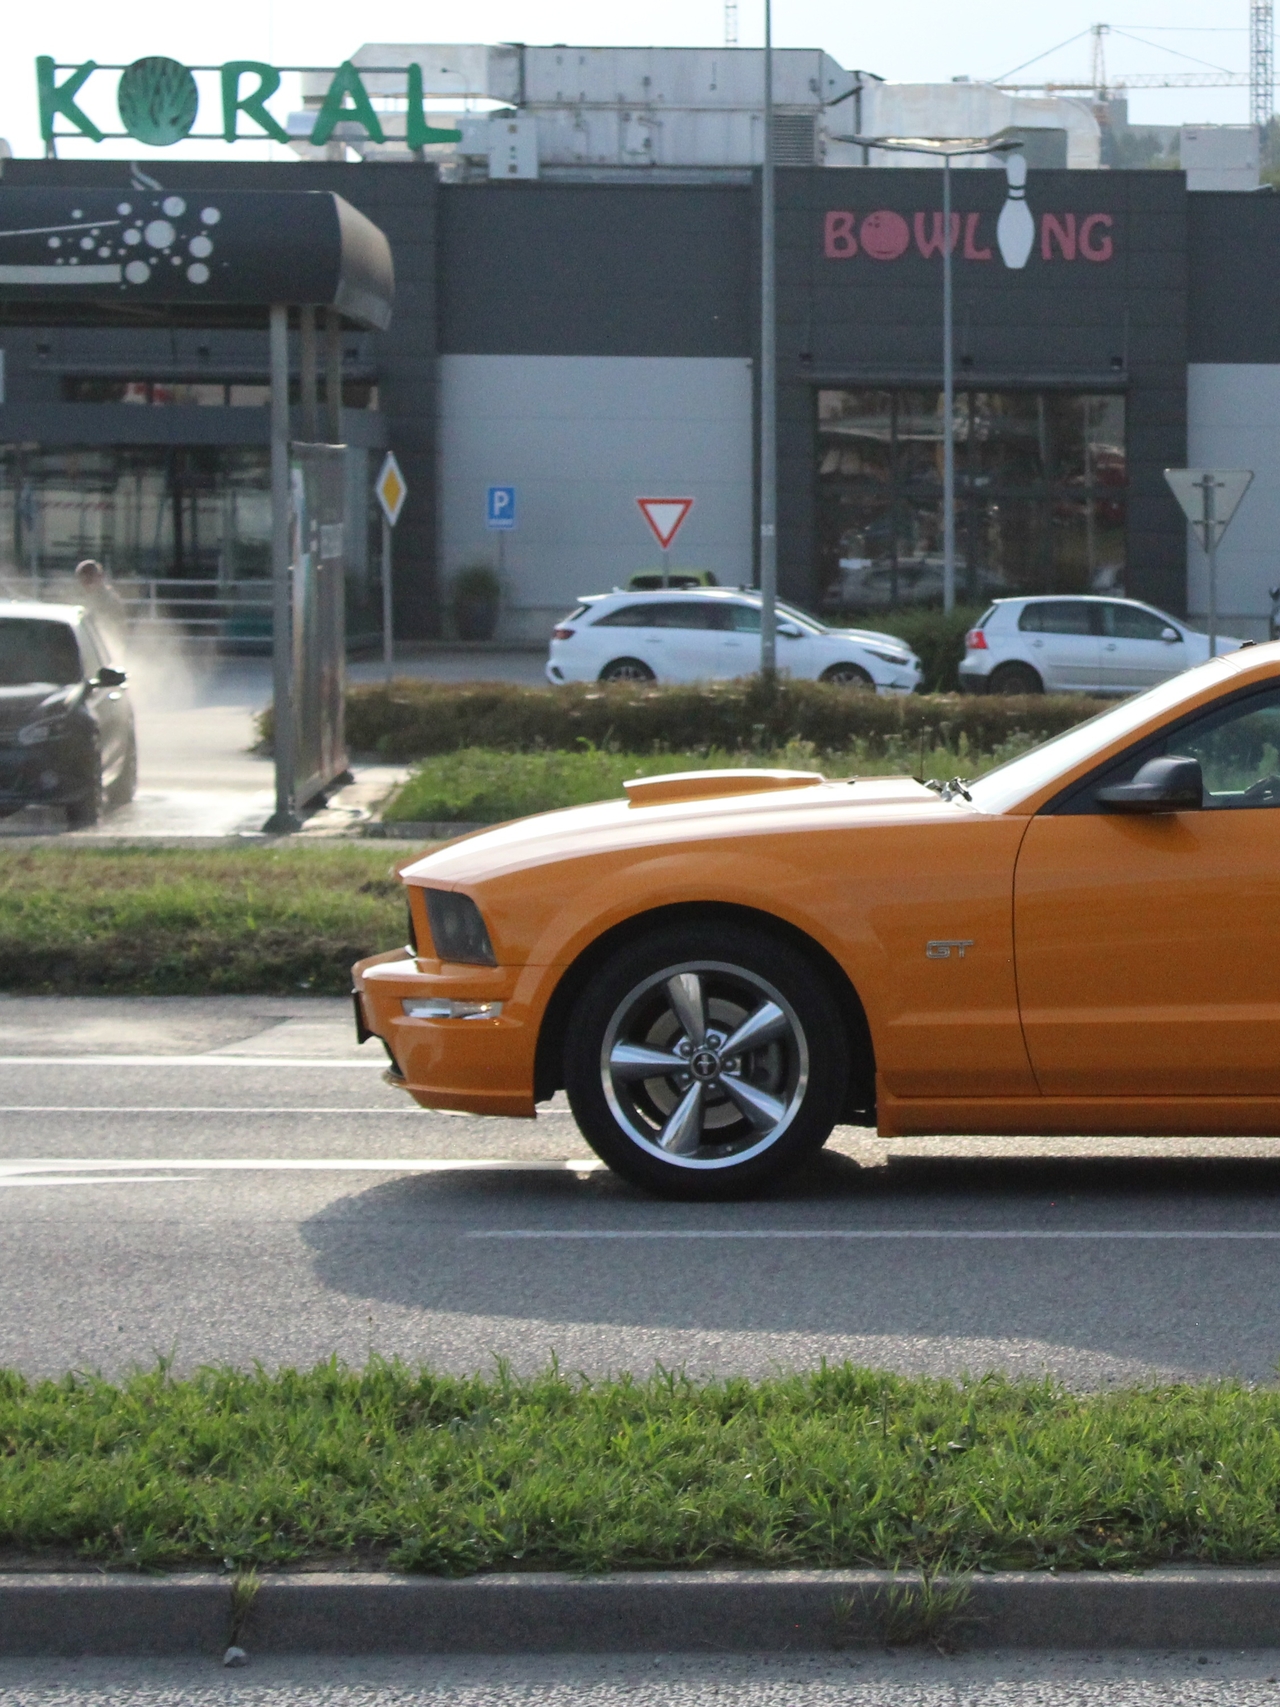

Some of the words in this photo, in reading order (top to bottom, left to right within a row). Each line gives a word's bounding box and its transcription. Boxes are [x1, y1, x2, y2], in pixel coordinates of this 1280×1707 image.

[36, 55, 463, 151] KORAL
[494, 491, 509, 515] P
[926, 940, 974, 958] GT
